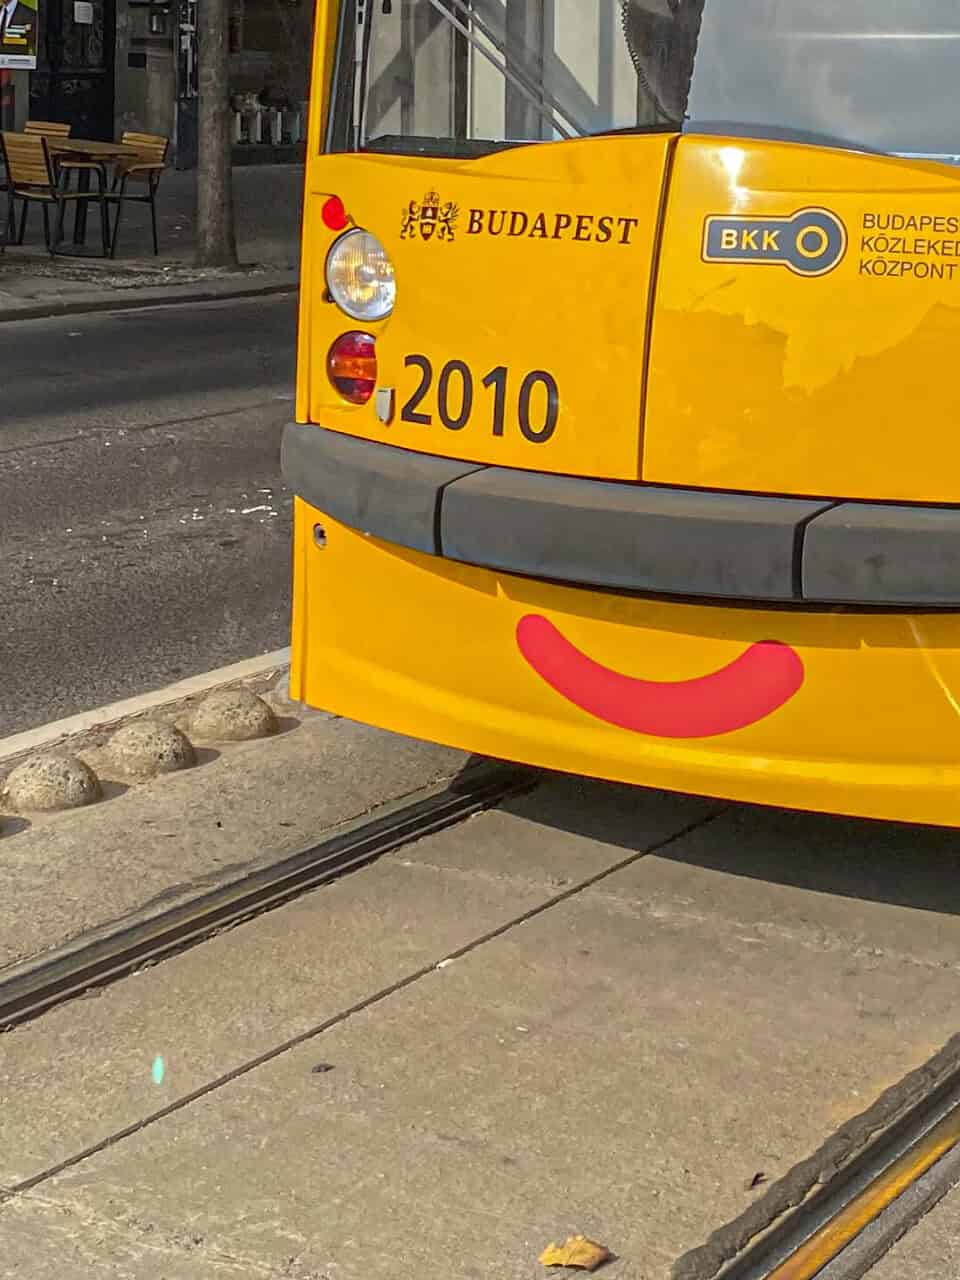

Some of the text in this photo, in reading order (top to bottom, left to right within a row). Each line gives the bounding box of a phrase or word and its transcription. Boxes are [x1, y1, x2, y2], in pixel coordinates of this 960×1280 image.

[465, 208, 638, 245] BUDAPEST
[720, 228, 781, 252] BKK
[858, 258, 959, 281] KÖZPONT
[400, 353, 560, 444] 2010
